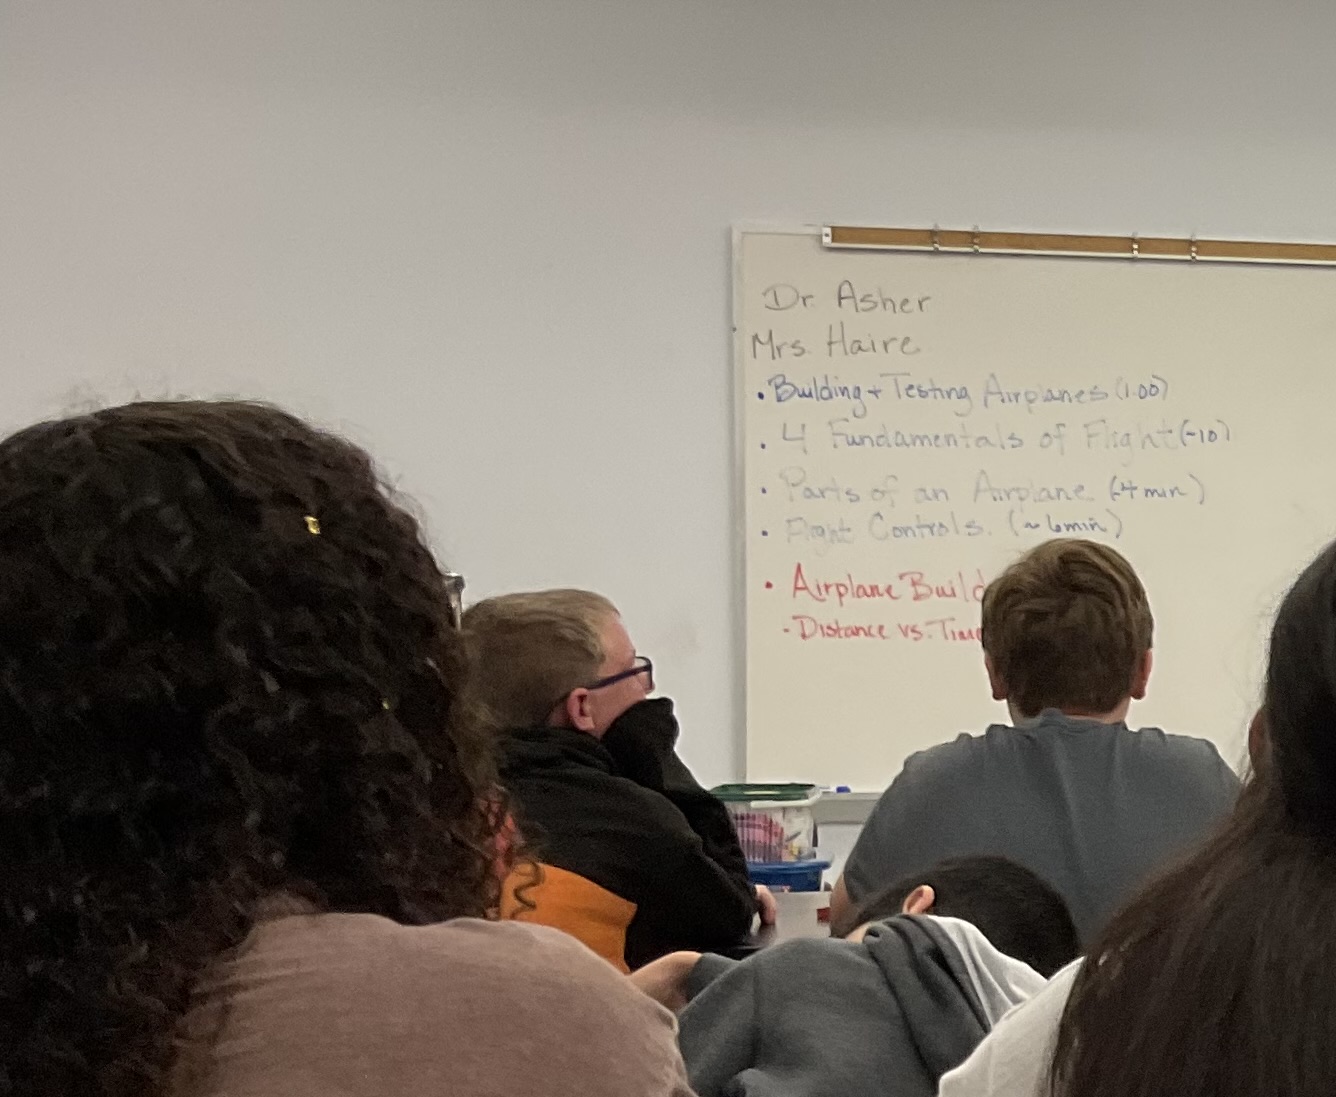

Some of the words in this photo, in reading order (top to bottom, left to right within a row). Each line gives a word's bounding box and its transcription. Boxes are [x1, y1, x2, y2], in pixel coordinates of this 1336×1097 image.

[836, 279, 932, 315] Asher
[826, 320, 922, 358] Haire
[781, 421, 808, 456] 4
[827, 416, 1025, 451] Fundamentals
[1039, 422, 1068, 457] of
[778, 465, 862, 503] Parts
[792, 561, 901, 608] Airplane
[791, 613, 893, 641] Distance
